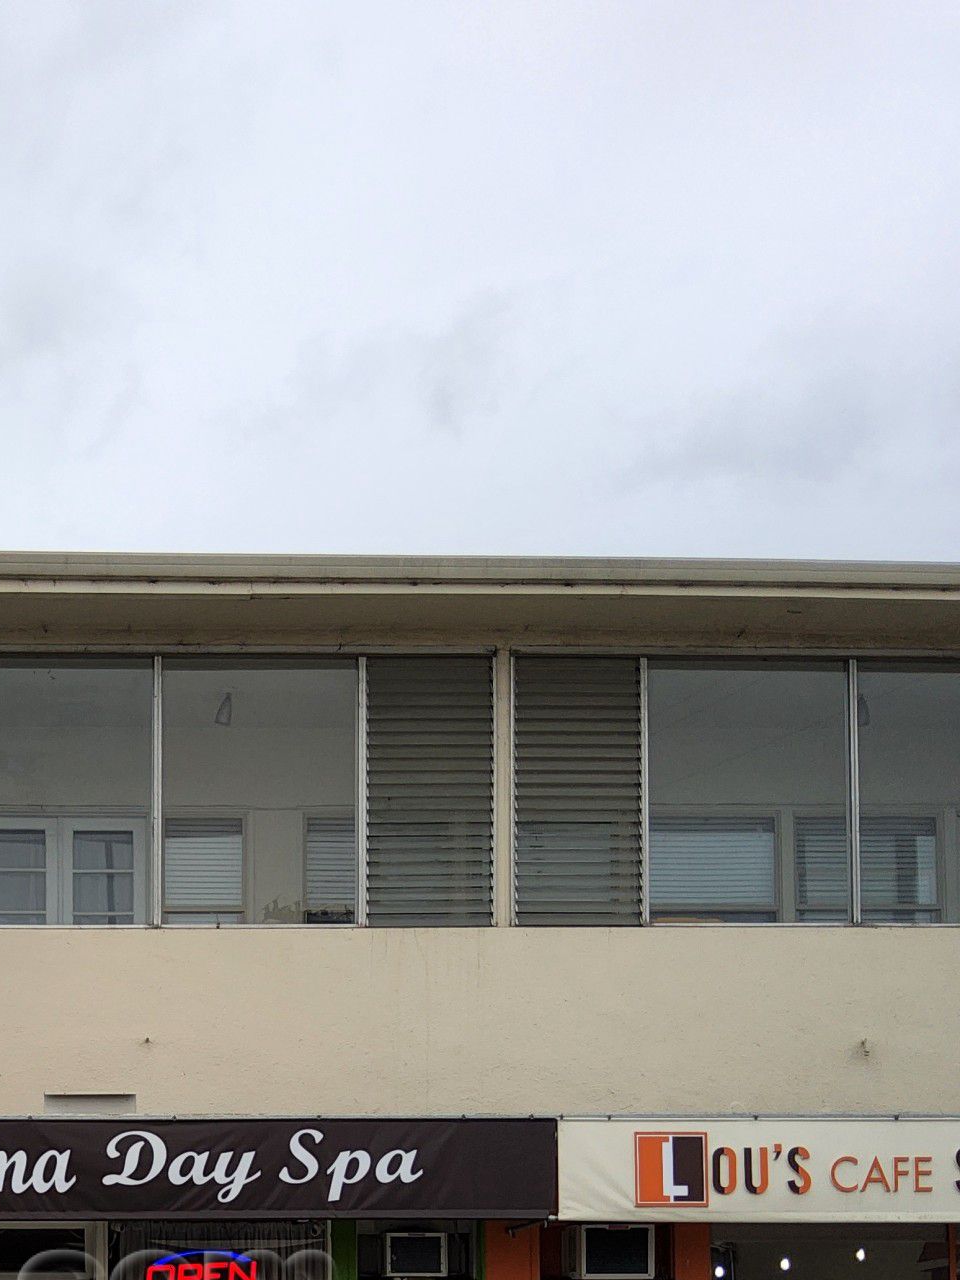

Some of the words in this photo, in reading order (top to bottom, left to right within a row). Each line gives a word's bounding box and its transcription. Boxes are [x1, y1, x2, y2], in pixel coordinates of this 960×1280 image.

[102, 1130, 261, 1203] Day
[279, 1128, 423, 1202] Spa
[661, 1136, 812, 1198] LOU'S
[830, 1155, 933, 1193] CAFE
